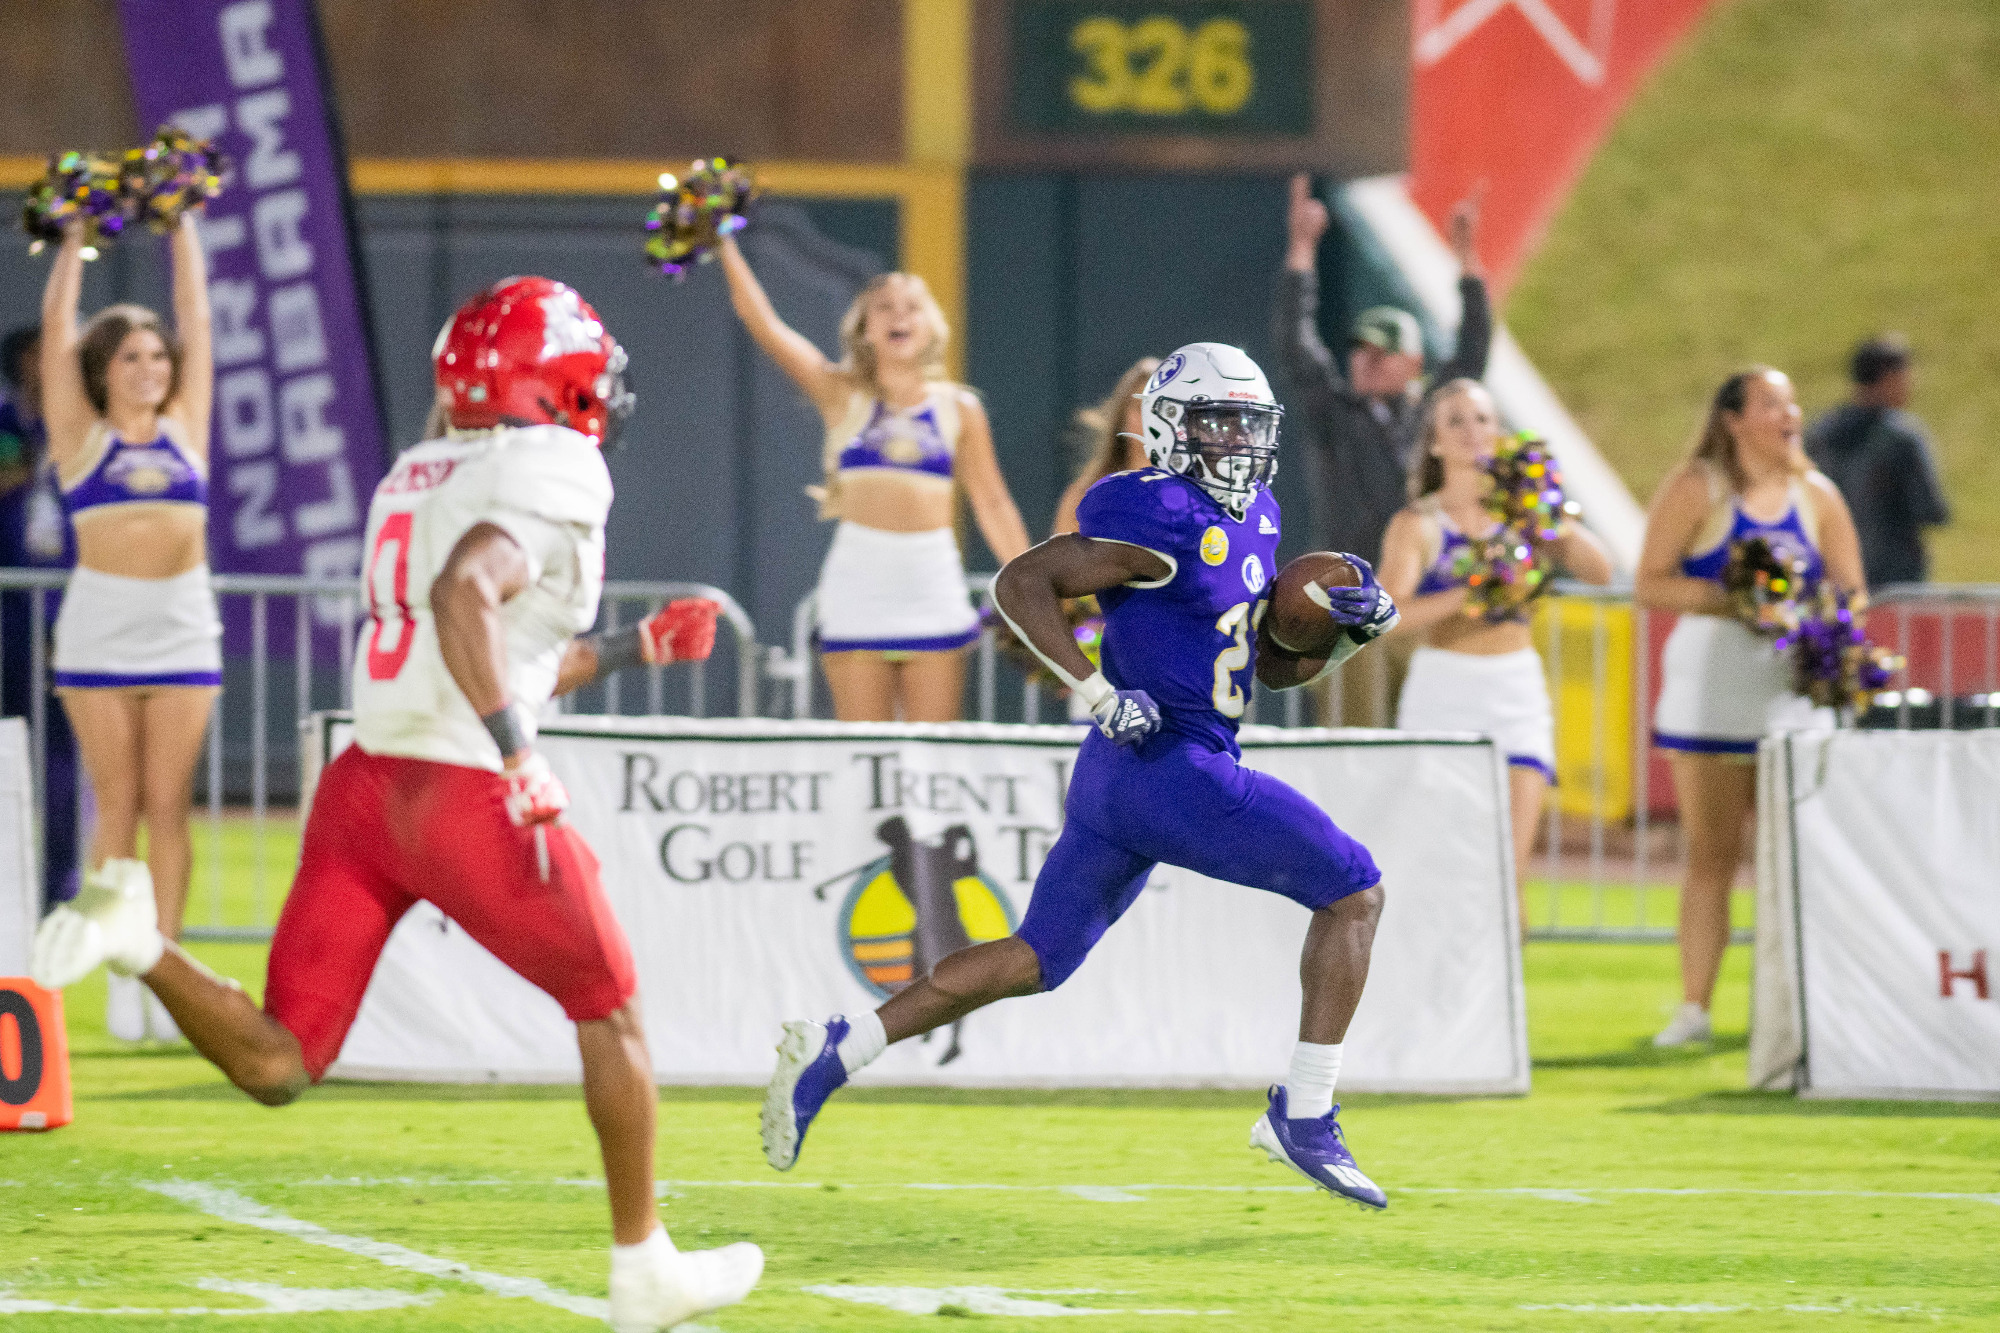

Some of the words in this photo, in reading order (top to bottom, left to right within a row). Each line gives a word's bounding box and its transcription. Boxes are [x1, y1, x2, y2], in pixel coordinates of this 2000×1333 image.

[1069, 16, 1252, 114] 326
[220, 0, 364, 626] ALABAMA
[368, 511, 416, 680] 0
[1212, 599, 1269, 718] 2
[1117, 698, 1133, 731] adidas
[618, 752, 832, 813] ROBERT
[853, 752, 1031, 816] TRENT
[659, 823, 816, 885] GOLF
[1938, 949, 1990, 1000] H
